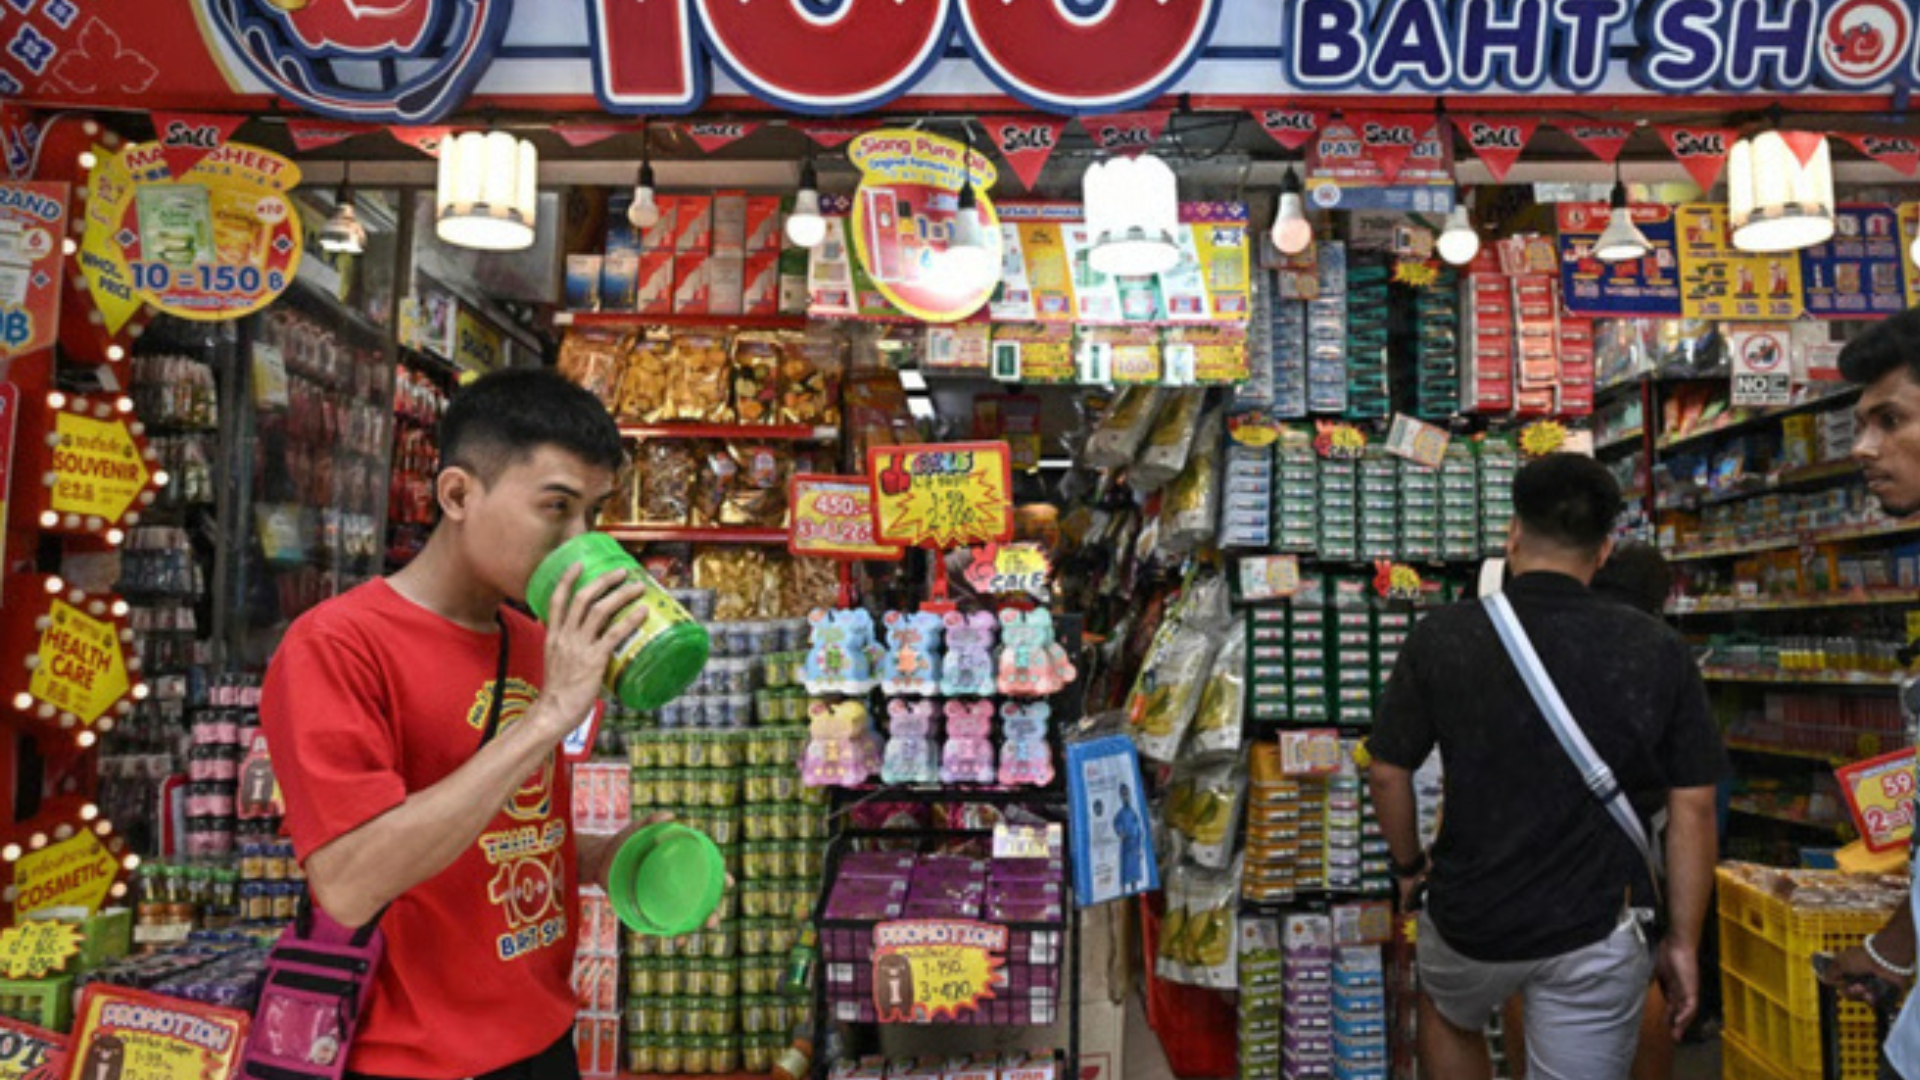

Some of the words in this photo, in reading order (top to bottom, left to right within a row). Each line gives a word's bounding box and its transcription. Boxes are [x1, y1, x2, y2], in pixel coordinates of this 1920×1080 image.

[1294, 0, 1622, 87] BAHT
[1649, 0, 1920, 88] SHO
[132, 263, 169, 290] 10
[198, 265, 261, 292] 150
[54, 452, 139, 483] SOUVENIR
[44, 630, 112, 673] HEALTH
[51, 654, 96, 691] CARE
[17, 857, 108, 913] COSMETIC
[102, 1001, 231, 1052] PROMOTION
